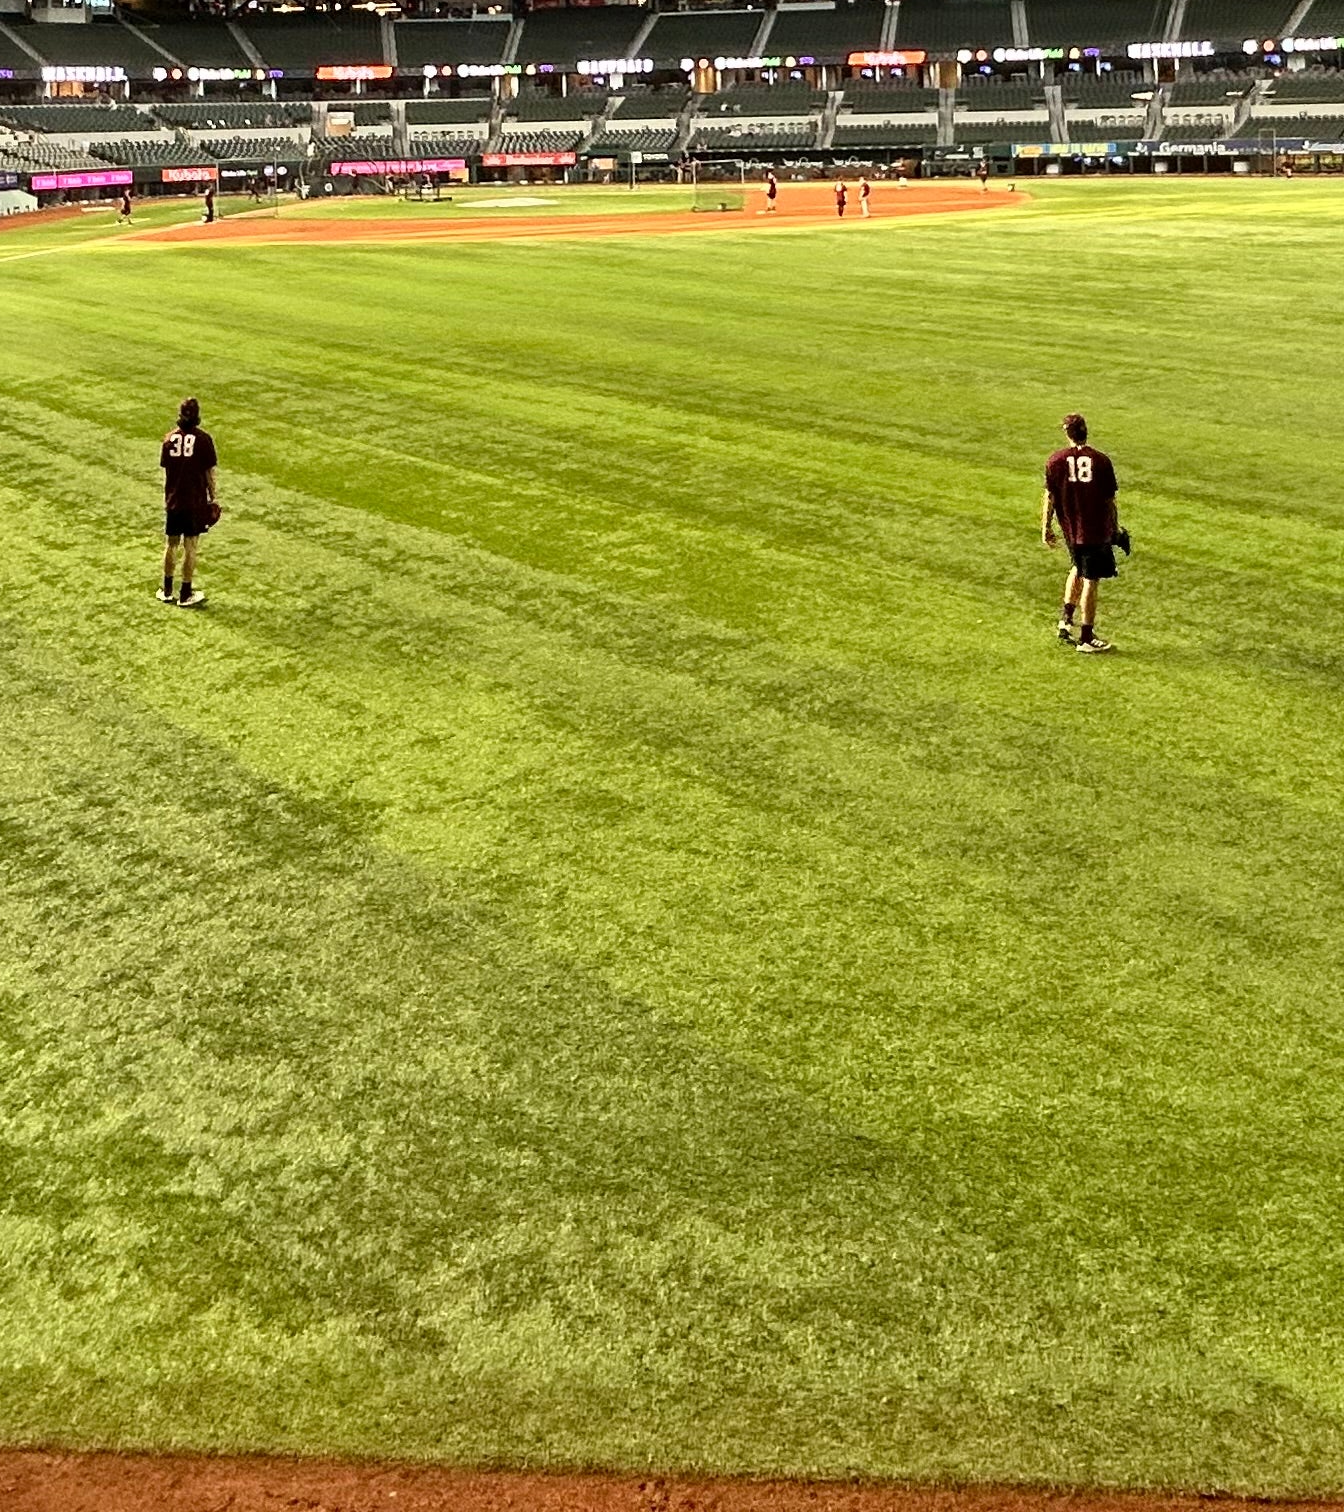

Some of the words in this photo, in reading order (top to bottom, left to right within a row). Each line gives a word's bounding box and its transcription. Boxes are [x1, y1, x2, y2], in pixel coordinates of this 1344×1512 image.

[1158, 141, 1226, 155] Germania
[167, 167, 211, 181] Kubota
[169, 433, 196, 457] 38
[1066, 456, 1093, 483] 18
